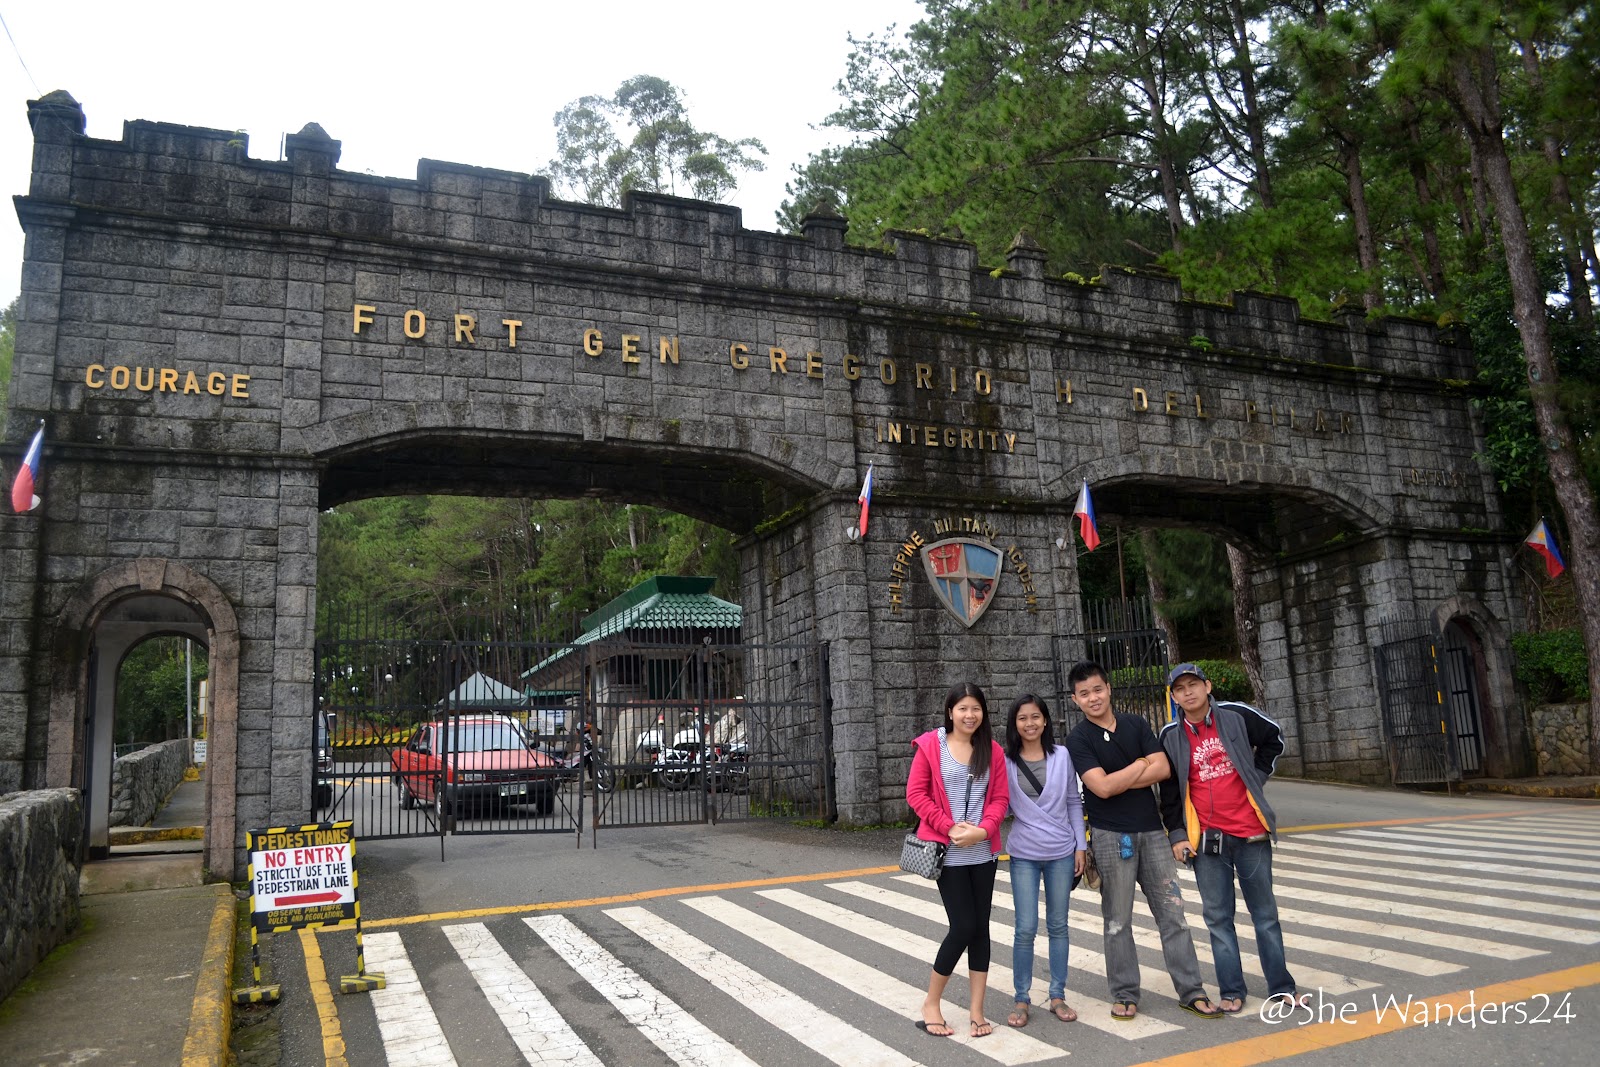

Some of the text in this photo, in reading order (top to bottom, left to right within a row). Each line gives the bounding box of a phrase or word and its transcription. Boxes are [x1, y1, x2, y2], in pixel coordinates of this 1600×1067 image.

[353, 304, 1351, 434] FORT GEN GREGORIO H DEL PILAR
[86, 364, 251, 398] COURAGE
[877, 421, 1016, 453] INTEGRITY
[888, 516, 1038, 615] PHILIPPINE MILITARY ACADEMY
[257, 829, 349, 850] PEDESTRIANS
[265, 845, 346, 868] NO ENTRY
[256, 862, 347, 882] STRICTLY USE THE
[258, 875, 349, 895] PEDESTRIAN LANE
[267, 908, 302, 918] OBSERVE
[320, 904, 342, 912] TRAFFIC
[268, 916, 288, 925] RULES
[291, 914, 303, 922] AND
